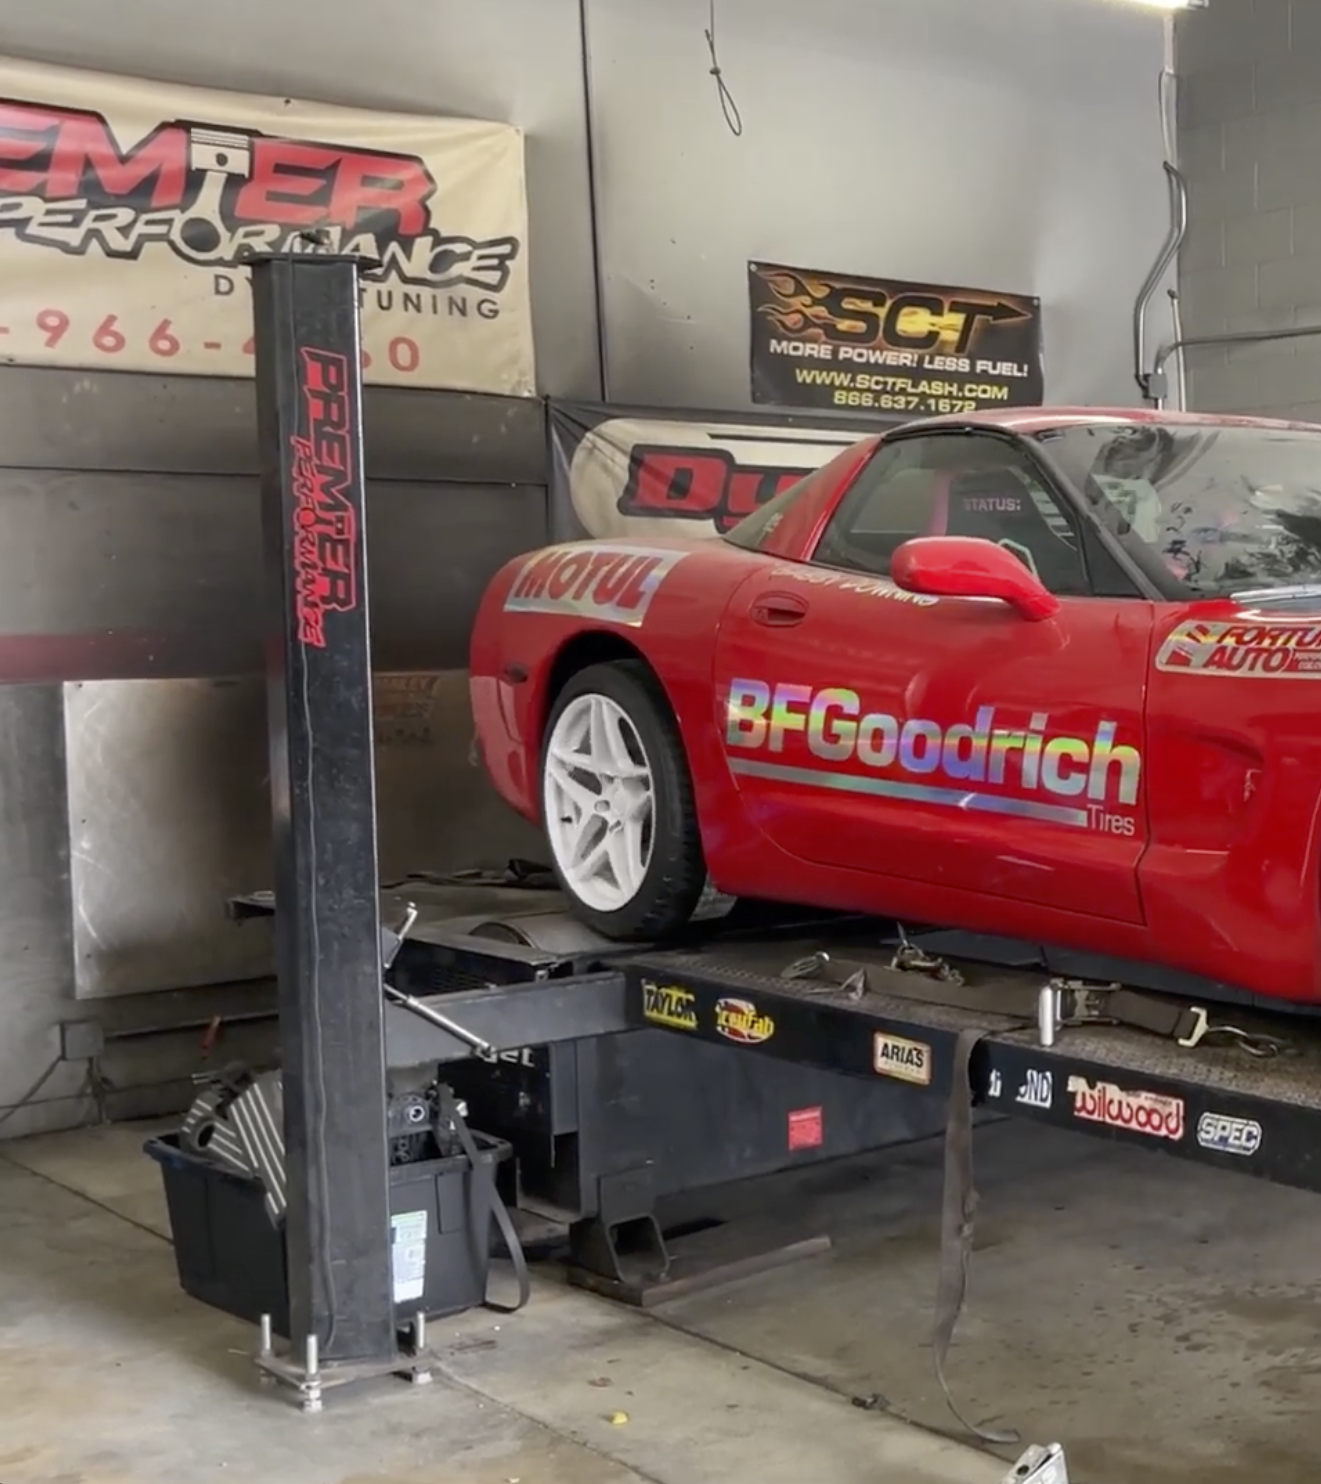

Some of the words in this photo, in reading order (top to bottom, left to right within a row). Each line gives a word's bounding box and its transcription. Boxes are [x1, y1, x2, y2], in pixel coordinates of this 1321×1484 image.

[812, 284, 1032, 356] SCT
[769, 339, 833, 360] MORE
[838, 347, 919, 368] POWER!
[923, 355, 971, 373] LESS
[975, 360, 1029, 377] FUEL!
[795, 369, 1009, 400] WWW.SCTFLASH.COM
[833, 390, 978, 413] 866.637.1672
[302, 347, 355, 612] PREMIER
[962, 498, 1021, 512] STATUS:
[290, 434, 327, 647] PERFORMANCE
[514, 550, 663, 610] MOTUL
[1202, 645, 1291, 673] AUTO
[726, 678, 1141, 805] BFGoodrich
[1087, 804, 1135, 836] Tires
[880, 1042, 925, 1069] ARIAS
[1201, 1117, 1259, 1147] SPEC
